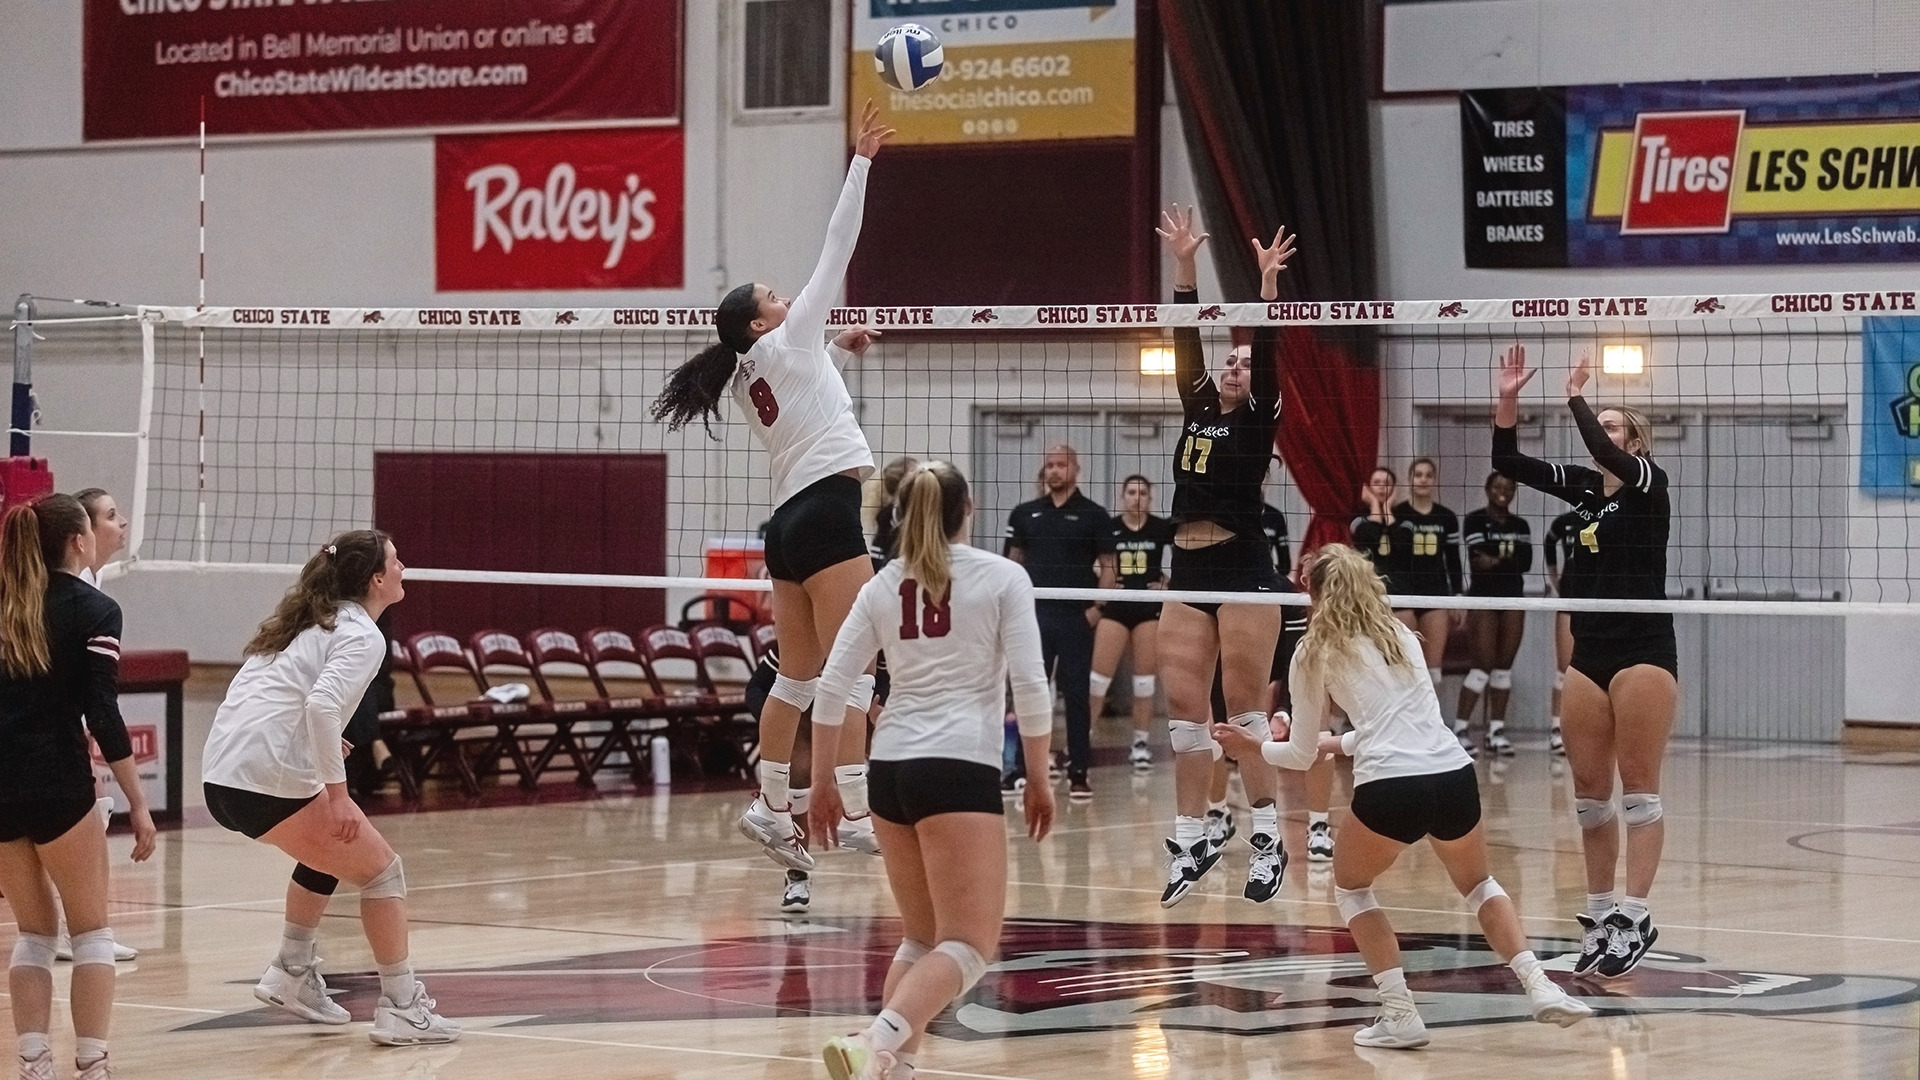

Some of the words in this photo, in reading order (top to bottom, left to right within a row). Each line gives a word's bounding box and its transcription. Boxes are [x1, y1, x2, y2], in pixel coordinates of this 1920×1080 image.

[941, 15, 1018, 33] CHICO
[156, 36, 233, 65] Located
[238, 34, 257, 61] in
[262, 33, 301, 60] Bell
[305, 27, 401, 57] Memorial
[406, 24, 469, 52] Union
[473, 27, 497, 49] or
[501, 19, 568, 47] online
[572, 21, 596, 45] at
[214, 63, 528, 97] ChicoStateWildcatStore.com
[890, 85, 1094, 112] thesocialchico.com
[1492, 120, 1535, 138] TIRES
[1483, 154, 1545, 173] WHEELS
[1640, 134, 1730, 203] Tires
[1746, 149, 1809, 192] LES
[1476, 189, 1554, 208] BATTERIES
[465, 162, 657, 269] Raley's
[1486, 224, 1545, 243] BRAKES
[1267, 303, 1322, 321] CHICO
[1330, 301, 1394, 320] STATE
[1512, 298, 1569, 317] CHICO
[1578, 297, 1647, 316] STATE
[1771, 294, 1832, 313] CHICO
[1842, 291, 1916, 311] STATE
[233, 309, 274, 324] CHICO
[281, 309, 330, 324] STATE
[418, 309, 462, 325] CHICO
[469, 309, 521, 325] STATE
[613, 309, 659, 325] CHICO
[825, 308, 867, 325] HICO
[875, 308, 934, 325] STATE
[1037, 306, 1088, 324] CHICO
[1096, 305, 1158, 323] STATE
[749, 376, 779, 428] 8
[1181, 435, 1213, 474] 17
[899, 578, 952, 640] 18
